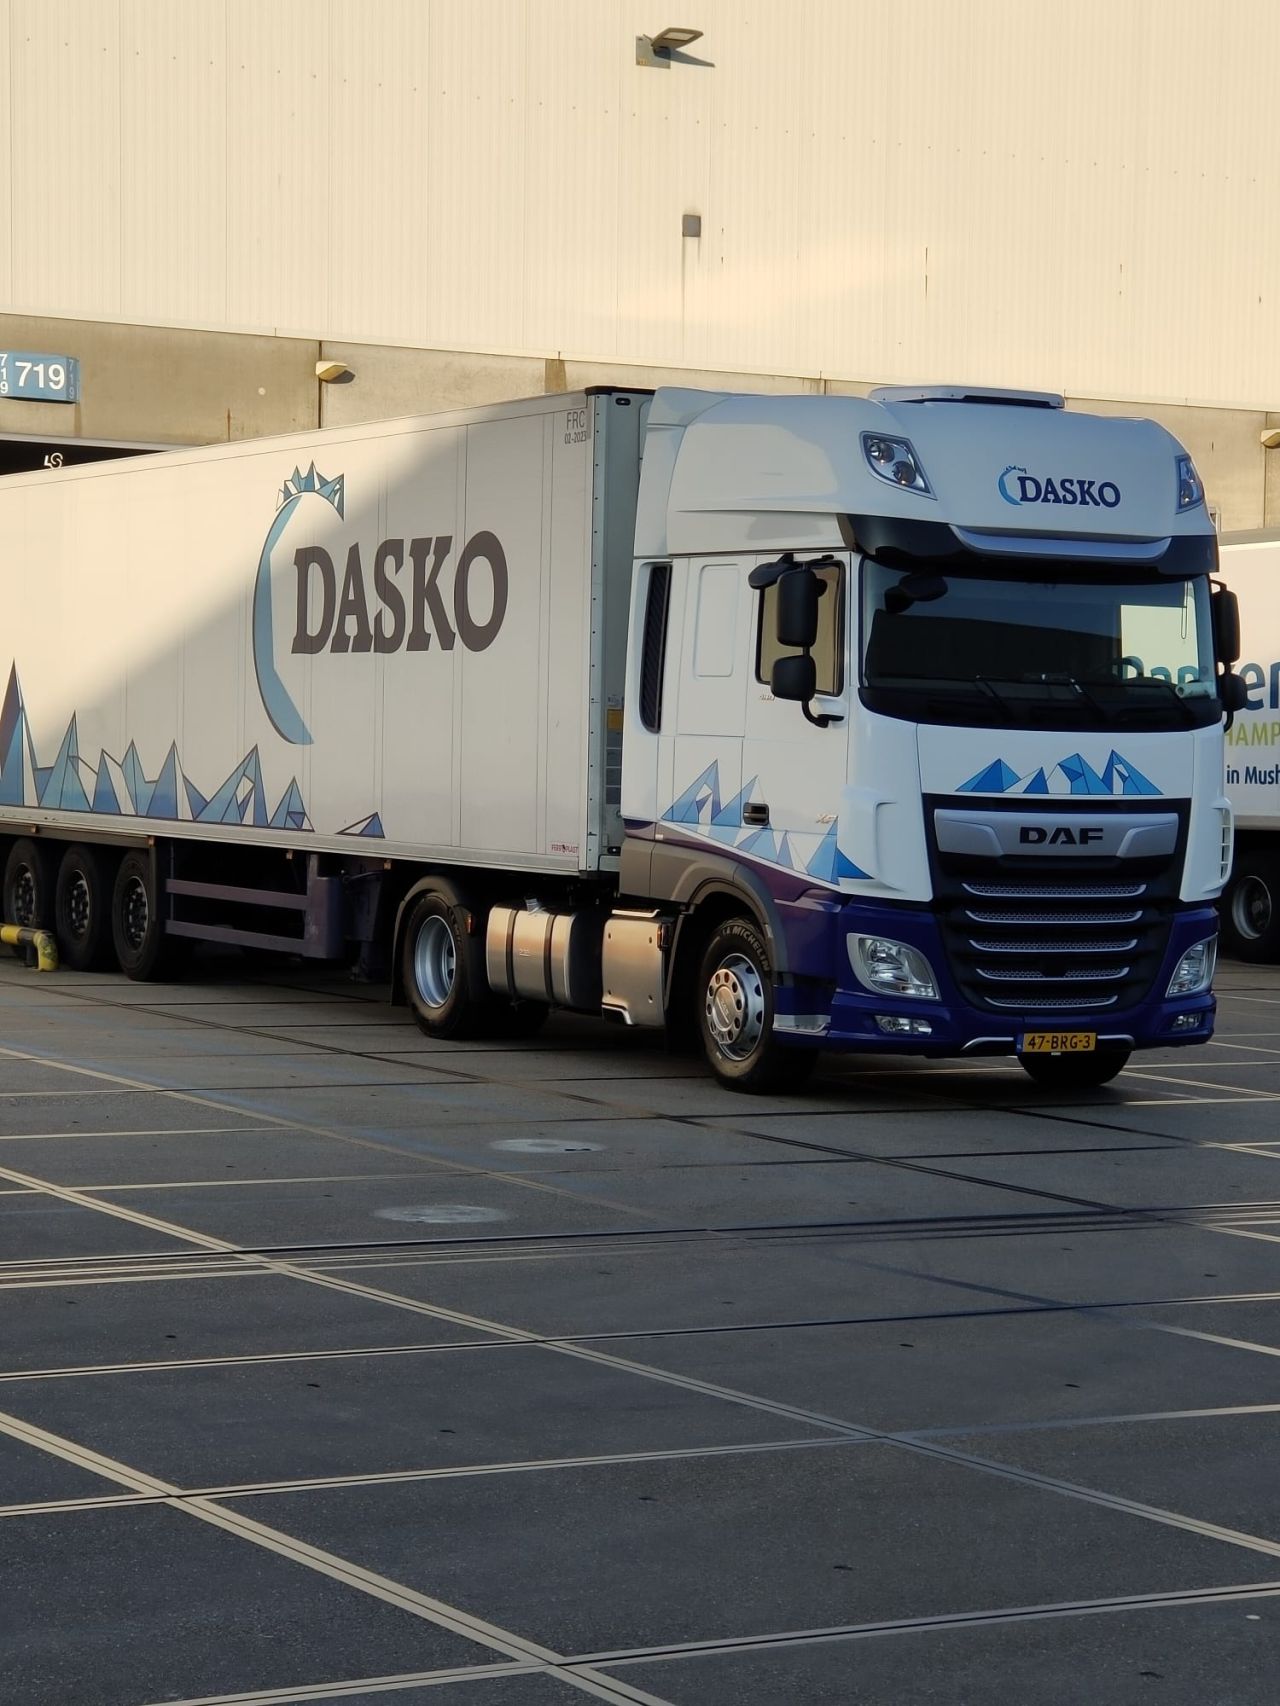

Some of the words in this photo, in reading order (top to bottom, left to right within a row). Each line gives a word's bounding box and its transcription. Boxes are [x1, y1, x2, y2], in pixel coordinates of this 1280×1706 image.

[15, 361, 65, 390] 719
[566, 410, 585, 430] FRC
[1017, 476, 1121, 508] DASKO
[291, 530, 509, 654] DASKO
[1226, 764, 1239, 784] in
[1019, 827, 1103, 845] DAF
[732, 925, 770, 971] MICHELIN
[1027, 1035, 1091, 1049] 47-BRG-3
